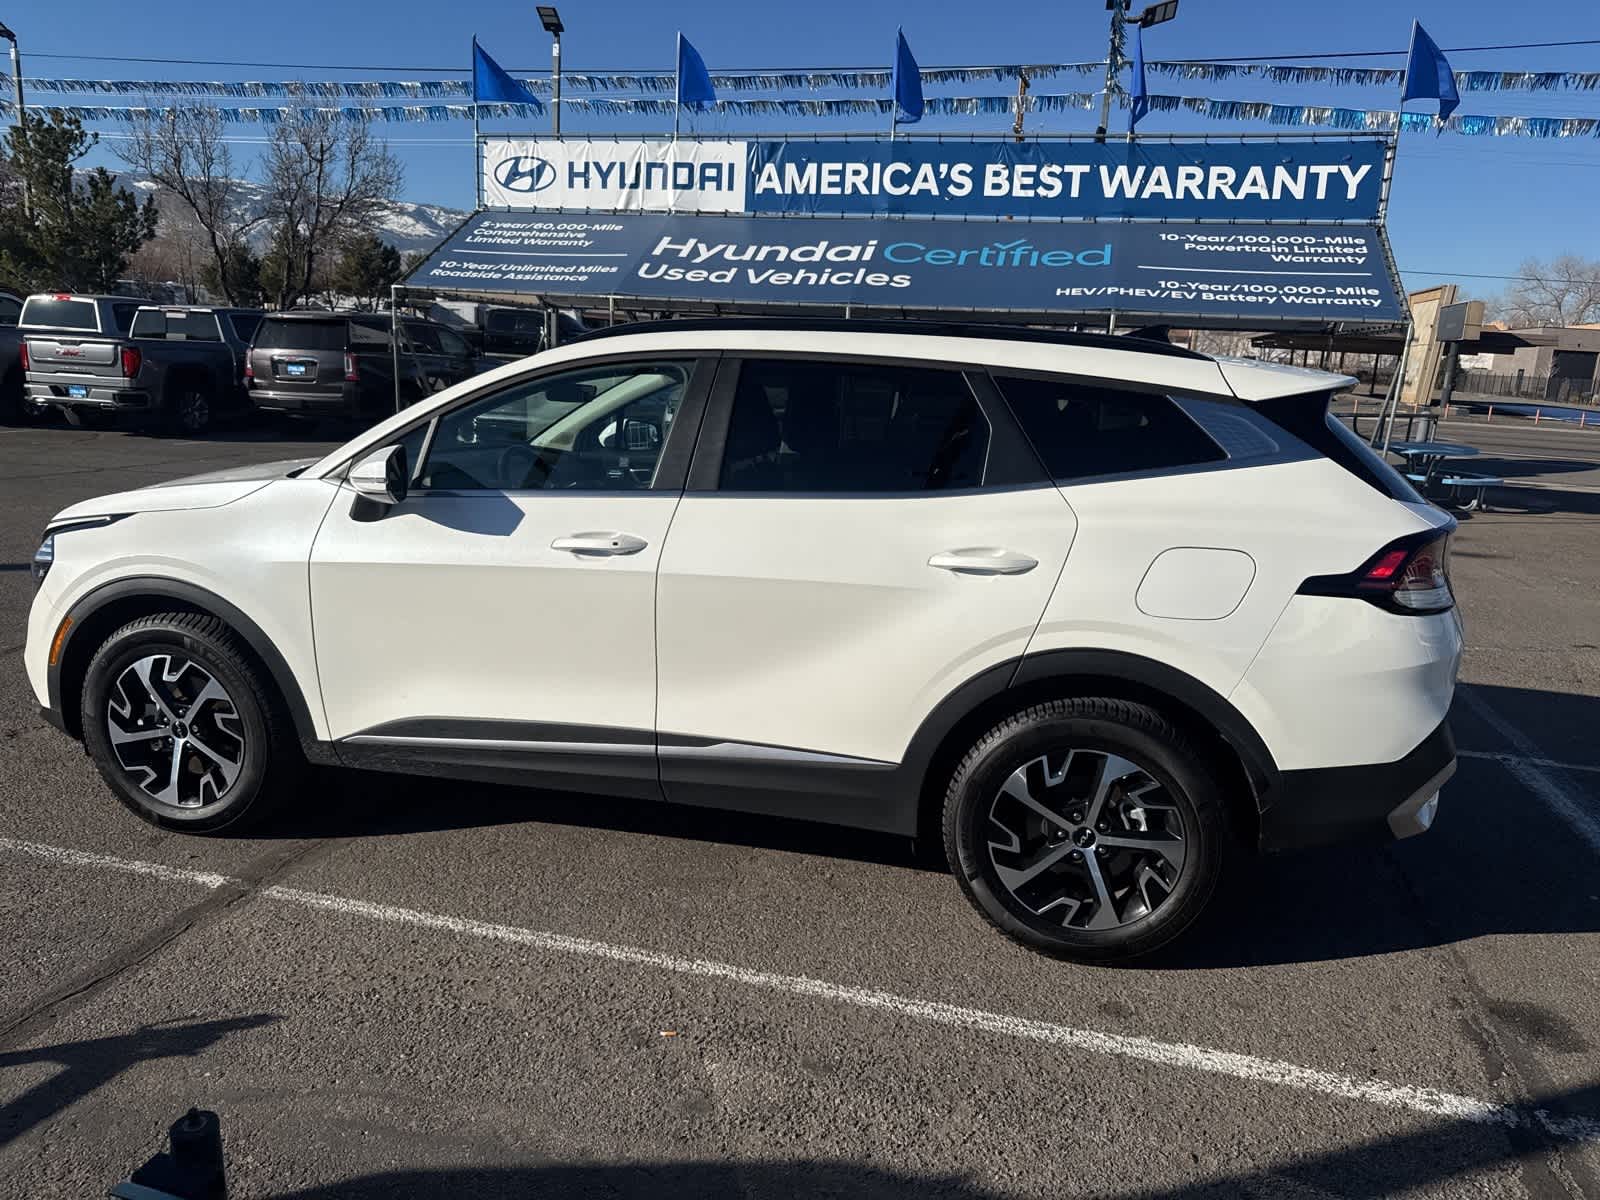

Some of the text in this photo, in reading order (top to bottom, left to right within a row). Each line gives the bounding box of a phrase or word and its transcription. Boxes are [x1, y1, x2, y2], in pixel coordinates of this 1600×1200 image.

[568, 161, 734, 191] HYUNDAI
[756, 160, 1372, 200] AMERICA'S BEST WARRANTY
[473, 228, 586, 238] Comprehensive
[1159, 233, 1366, 245] 10-Year/100,000-Mile
[465, 236, 593, 247] Limited Warranty
[1184, 242, 1368, 254] Powertrain Limited
[651, 236, 1112, 268] Hyundai Certified
[1271, 254, 1366, 264] Warranty
[439, 261, 618, 273] 10-Year/Unlimited Miles
[429, 268, 588, 282] Roadside Assistance
[637, 263, 912, 288] Used Vehicles
[1158, 280, 1380, 296] 10-Year/100,000-Mile
[1055, 287, 1382, 307] HEV/PHEV/EV Battery Warranty
